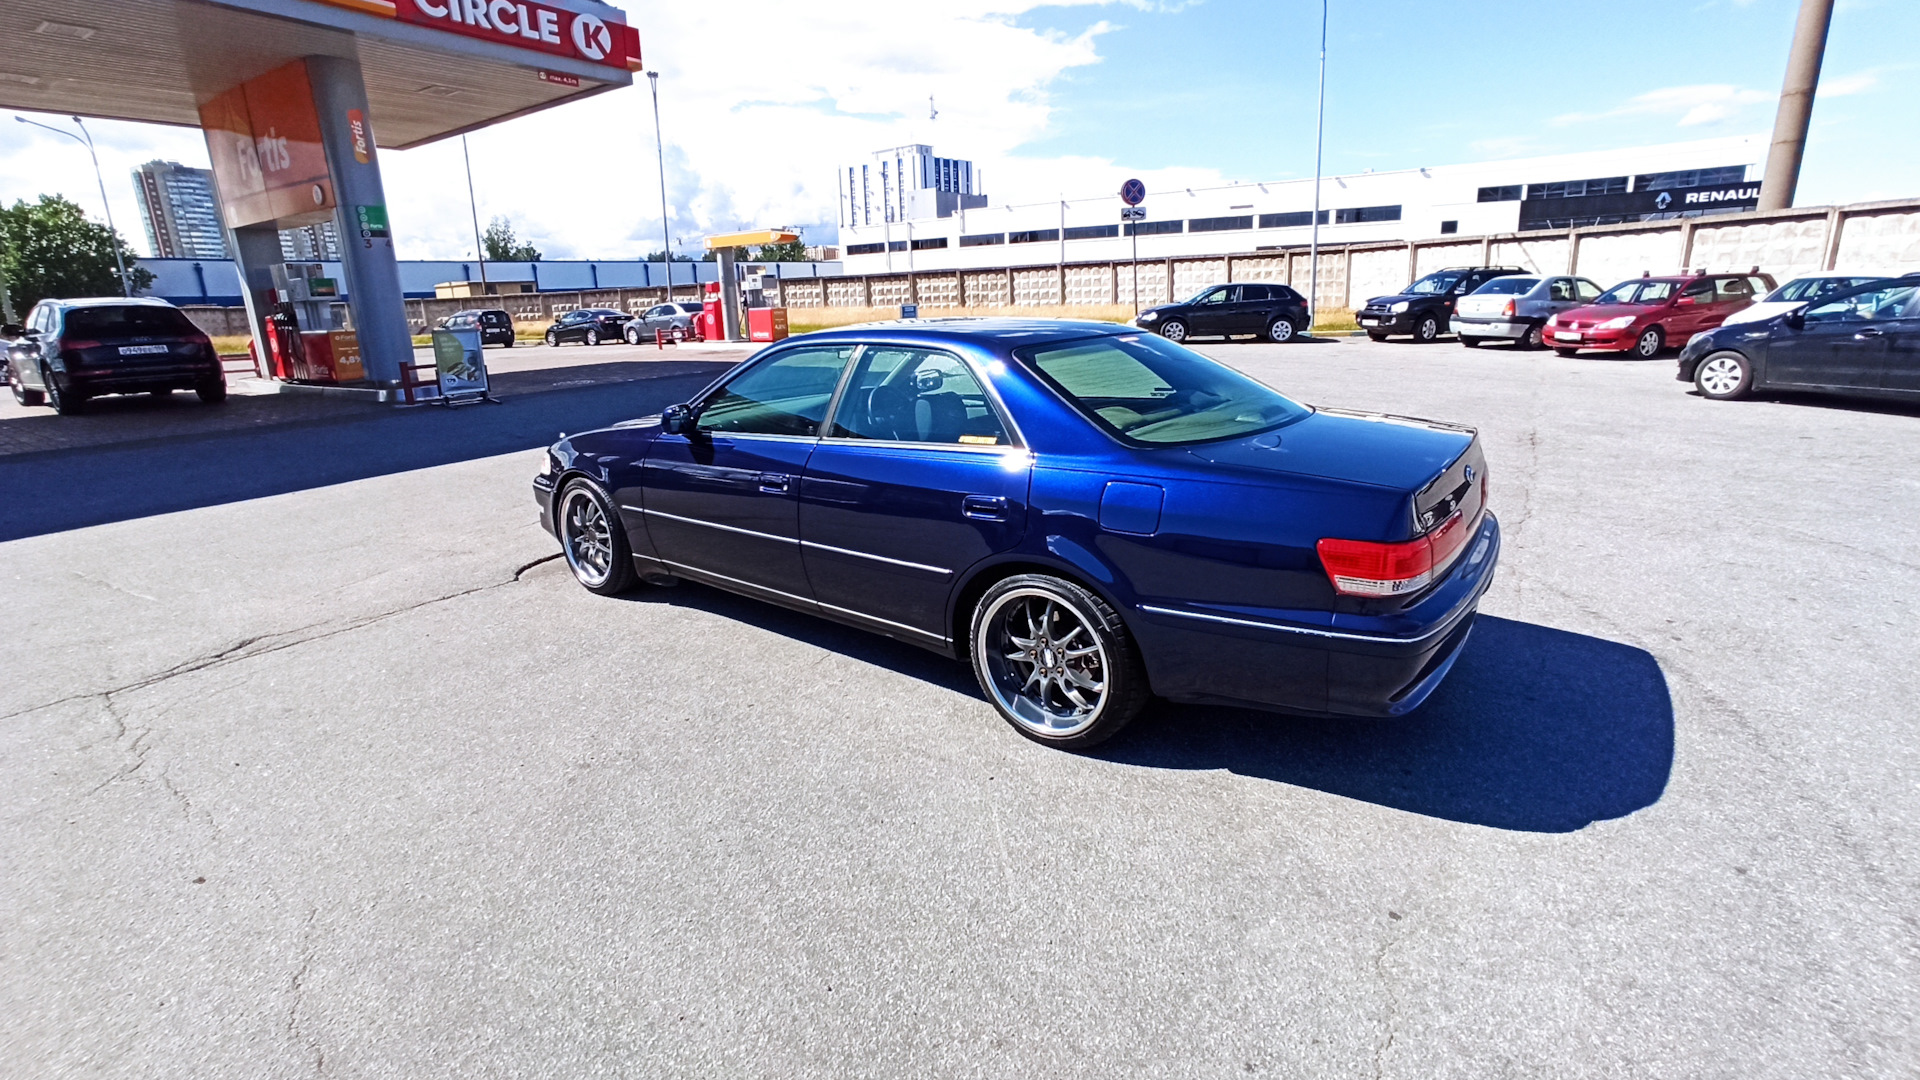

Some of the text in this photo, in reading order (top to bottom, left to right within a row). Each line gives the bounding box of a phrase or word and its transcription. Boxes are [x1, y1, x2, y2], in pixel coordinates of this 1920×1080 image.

[414, 0, 610, 59] CIRCLE K
[236, 126, 291, 180] Fortis
[351, 120, 368, 154] Fortis
[1685, 187, 1760, 204] RENAUL
[364, 239, 372, 249] 3
